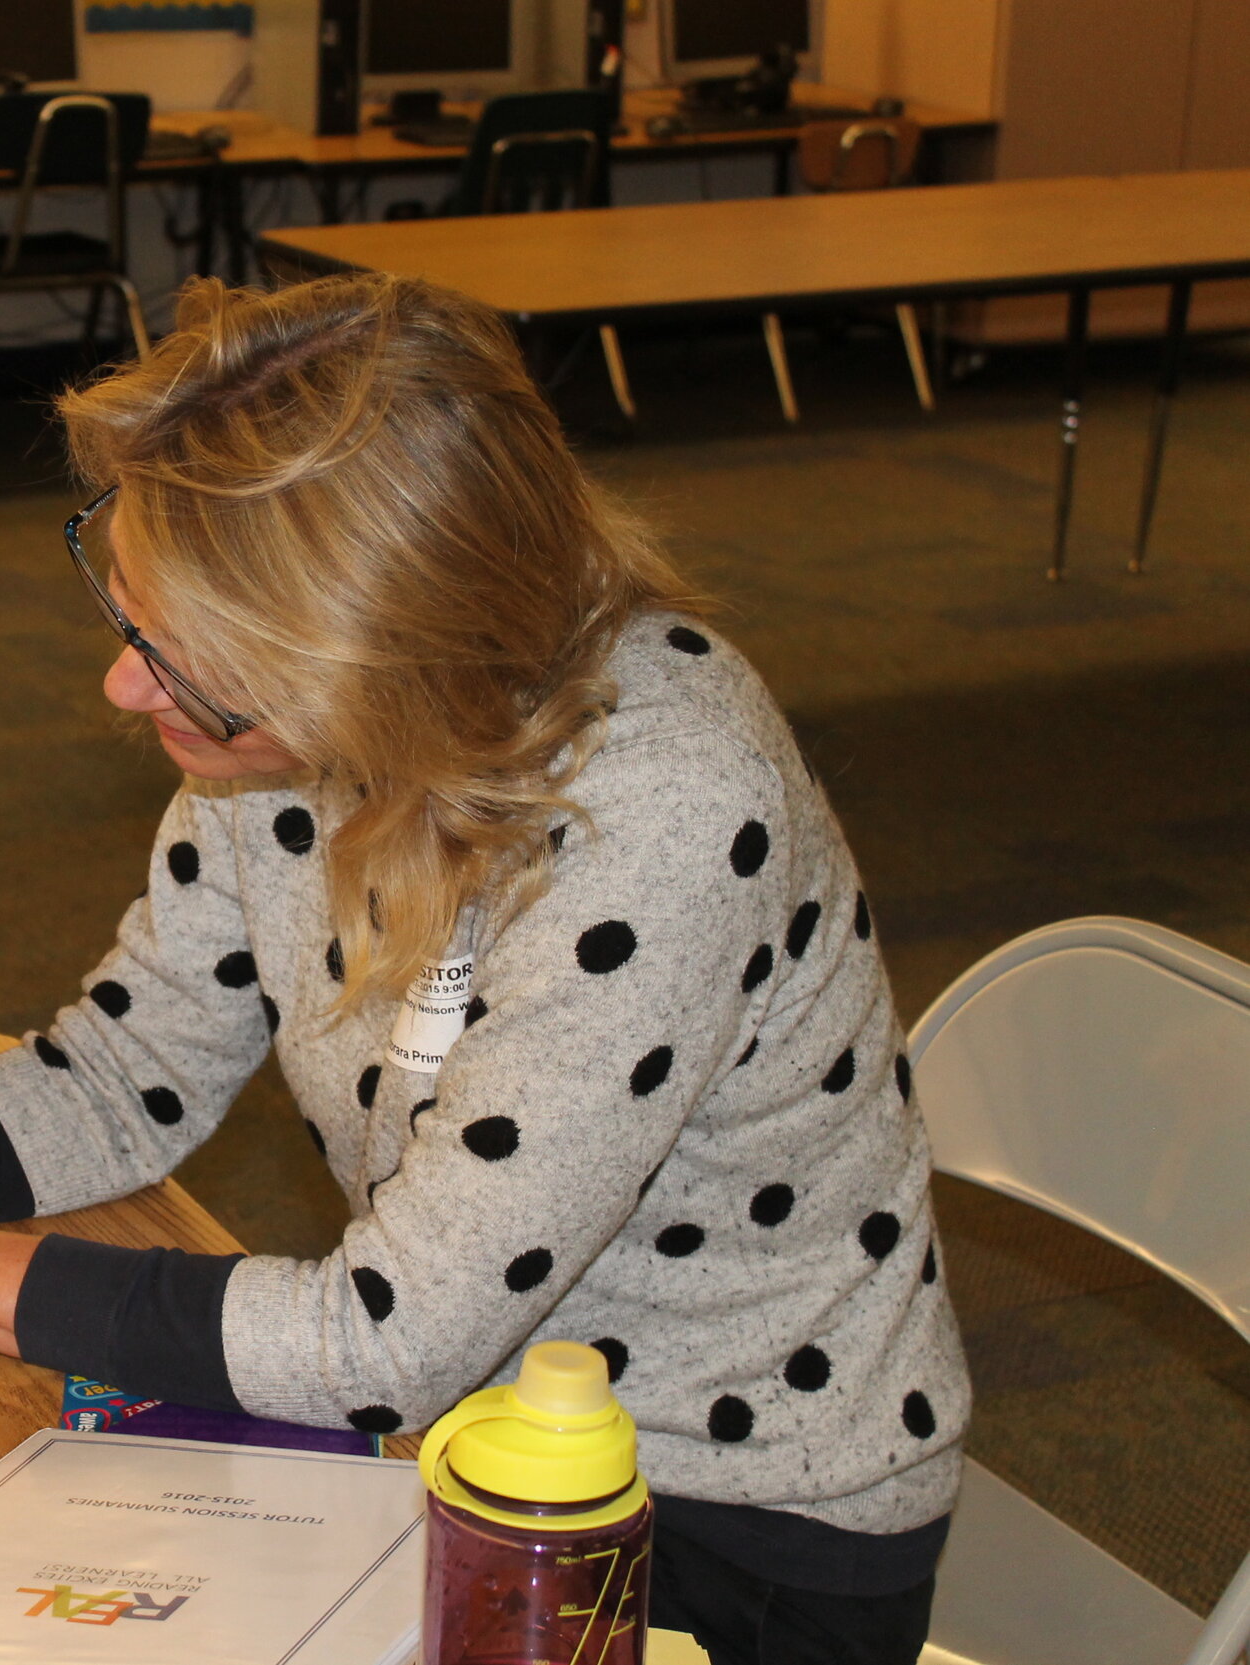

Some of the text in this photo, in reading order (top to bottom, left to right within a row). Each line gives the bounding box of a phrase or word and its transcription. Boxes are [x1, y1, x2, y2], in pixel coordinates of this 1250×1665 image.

[419, 962, 474, 981] SITOR
[442, 983, 465, 994] 9:00
[418, 1001, 470, 1014] Nelson-W
[412, 1050, 444, 1063] Prim
[161, 1492, 256, 1506] 2015-2016
[65, 1498, 327, 1525] TUTOR SESSION SUMMARIES
[32, 1572, 201, 1593] READING EXCITES
[42, 1564, 211, 1584] ALL LEARNERS!
[15, 1584, 190, 1626] REAL
